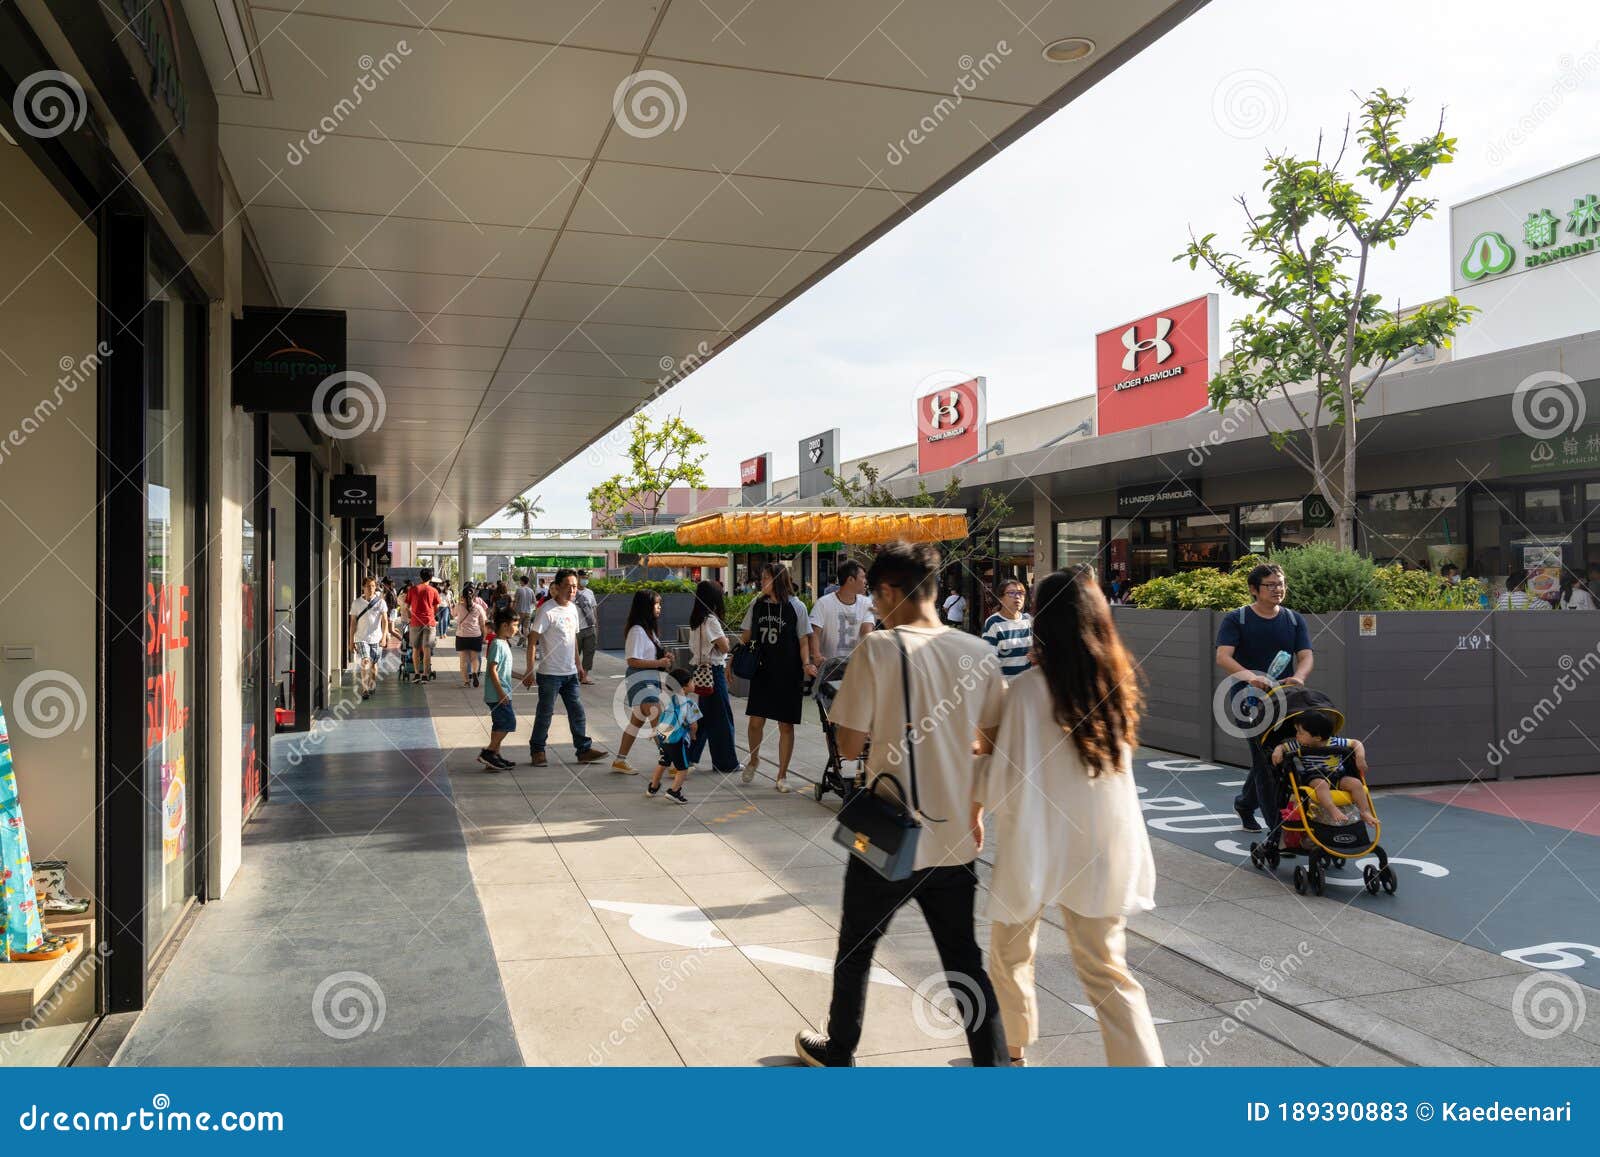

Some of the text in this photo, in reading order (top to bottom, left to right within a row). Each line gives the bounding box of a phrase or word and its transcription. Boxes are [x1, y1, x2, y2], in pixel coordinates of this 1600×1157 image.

[1522, 194, 1600, 250] 翰林
[1525, 239, 1594, 267] HANLIN
[1113, 366, 1185, 392] UNDER ARMOUR
[1129, 490, 1193, 505] UNDER ARMOUR
[147, 582, 189, 655] SALE
[760, 627, 778, 644] 76
